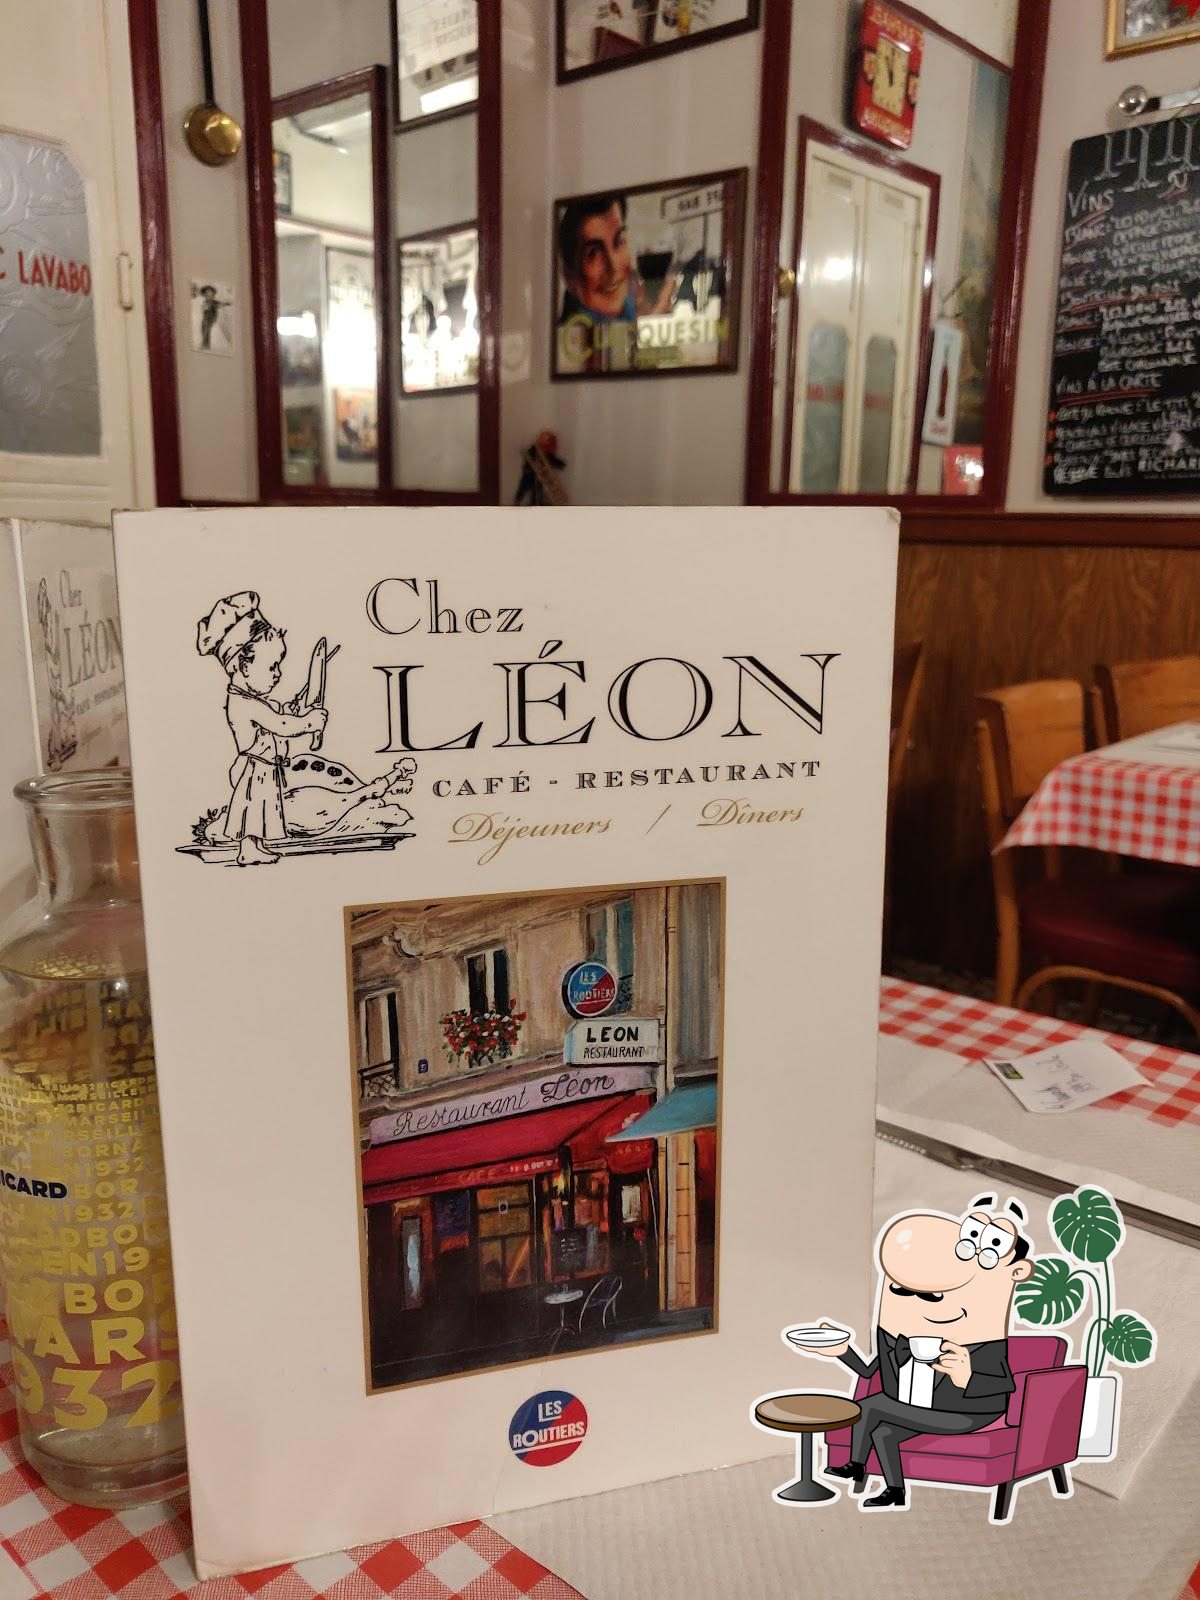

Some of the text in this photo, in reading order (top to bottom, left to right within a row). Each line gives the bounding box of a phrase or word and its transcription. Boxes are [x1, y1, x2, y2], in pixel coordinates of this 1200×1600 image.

[1068, 181, 1114, 218] VINS
[17, 251, 92, 297] LAVABO
[366, 577, 524, 635] Chez
[373, 639, 842, 754] LÉON
[432, 770, 531, 798] CAFÉ
[575, 760, 821, 791] RESTAURANT
[447, 811, 613, 866] Déjeuners
[696, 797, 805, 828] Dîners
[579, 970, 597, 985] LES
[583, 1046, 644, 1059] RESTAURANT
[586, 1026, 639, 1043] LEON
[393, 1071, 615, 1137] Restaurant Léon
[0, 1168, 68, 1199] ICARD
[63, 1279, 144, 1314] BO
[33, 1315, 147, 1365] AR
[537, 1399, 562, 1423] LES
[512, 1421, 585, 1449] ROUTIERS
